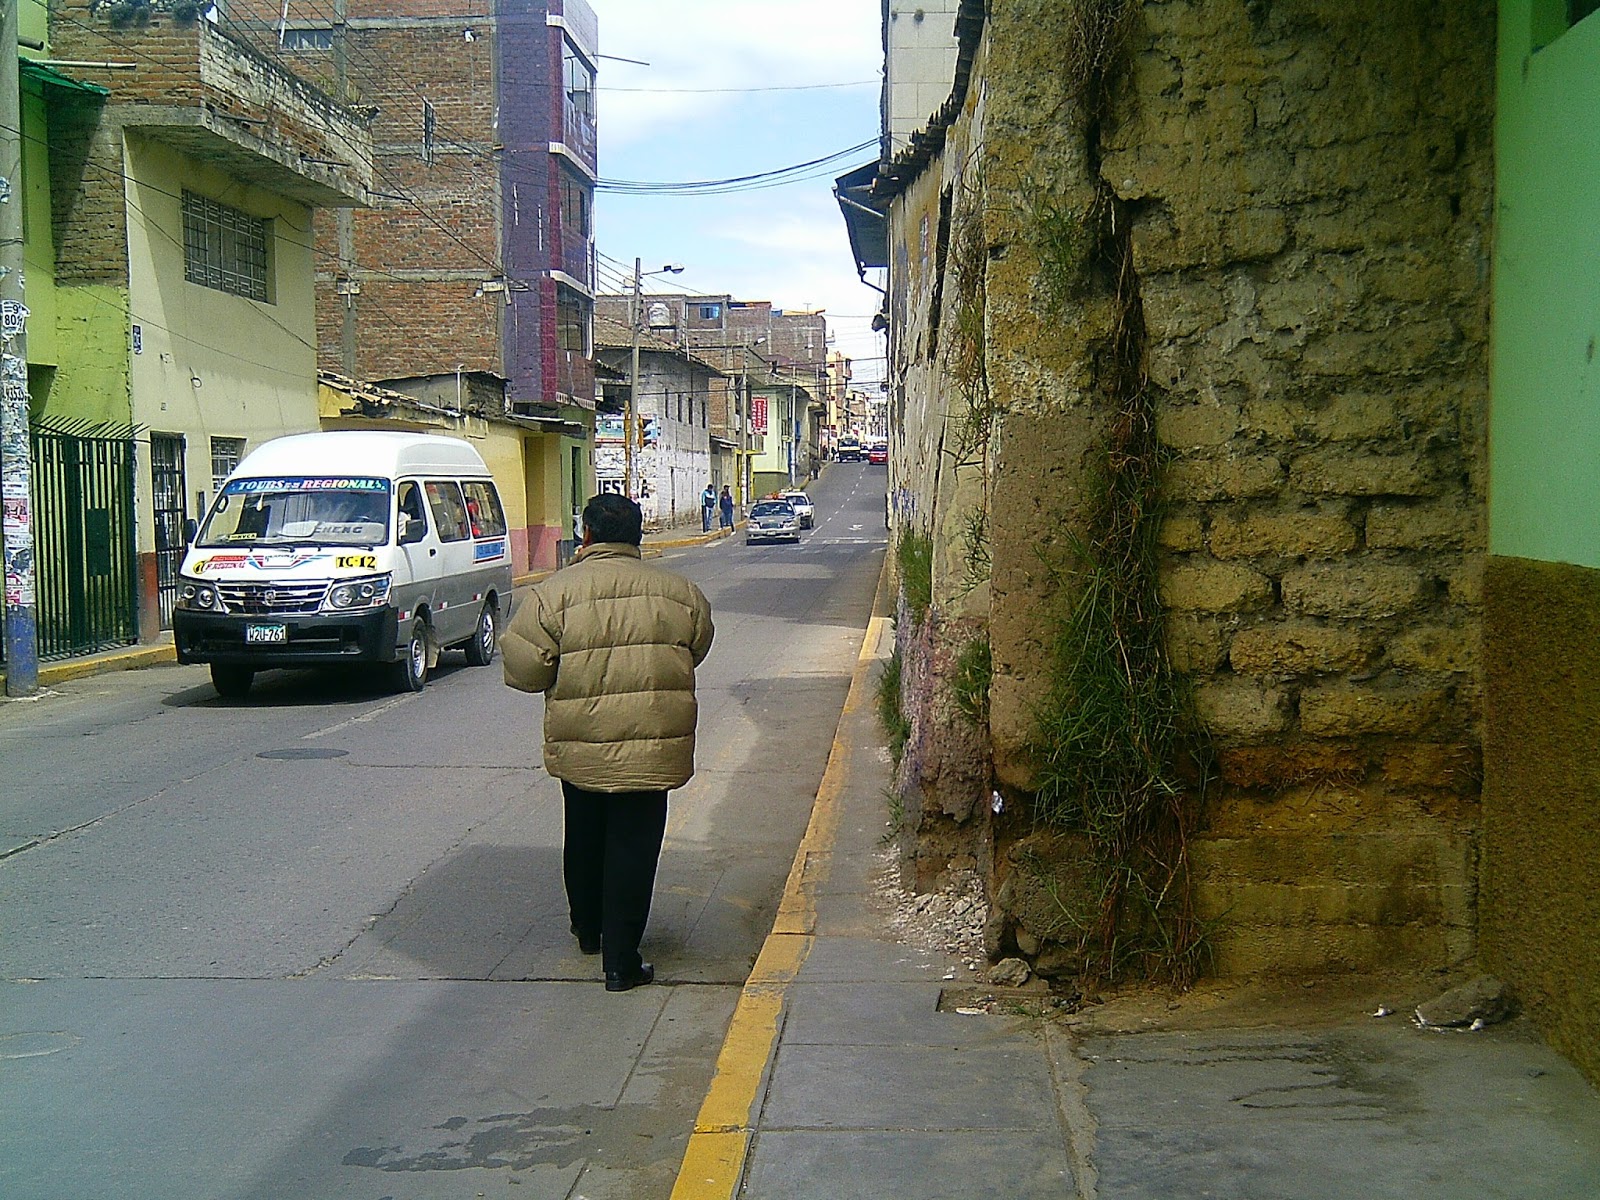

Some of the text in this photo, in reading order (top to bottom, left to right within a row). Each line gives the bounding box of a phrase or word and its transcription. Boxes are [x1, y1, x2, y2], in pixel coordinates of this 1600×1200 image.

[238, 480, 285, 490] TOURS
[300, 479, 375, 489] REGIONAL
[337, 556, 376, 569] TC-12
